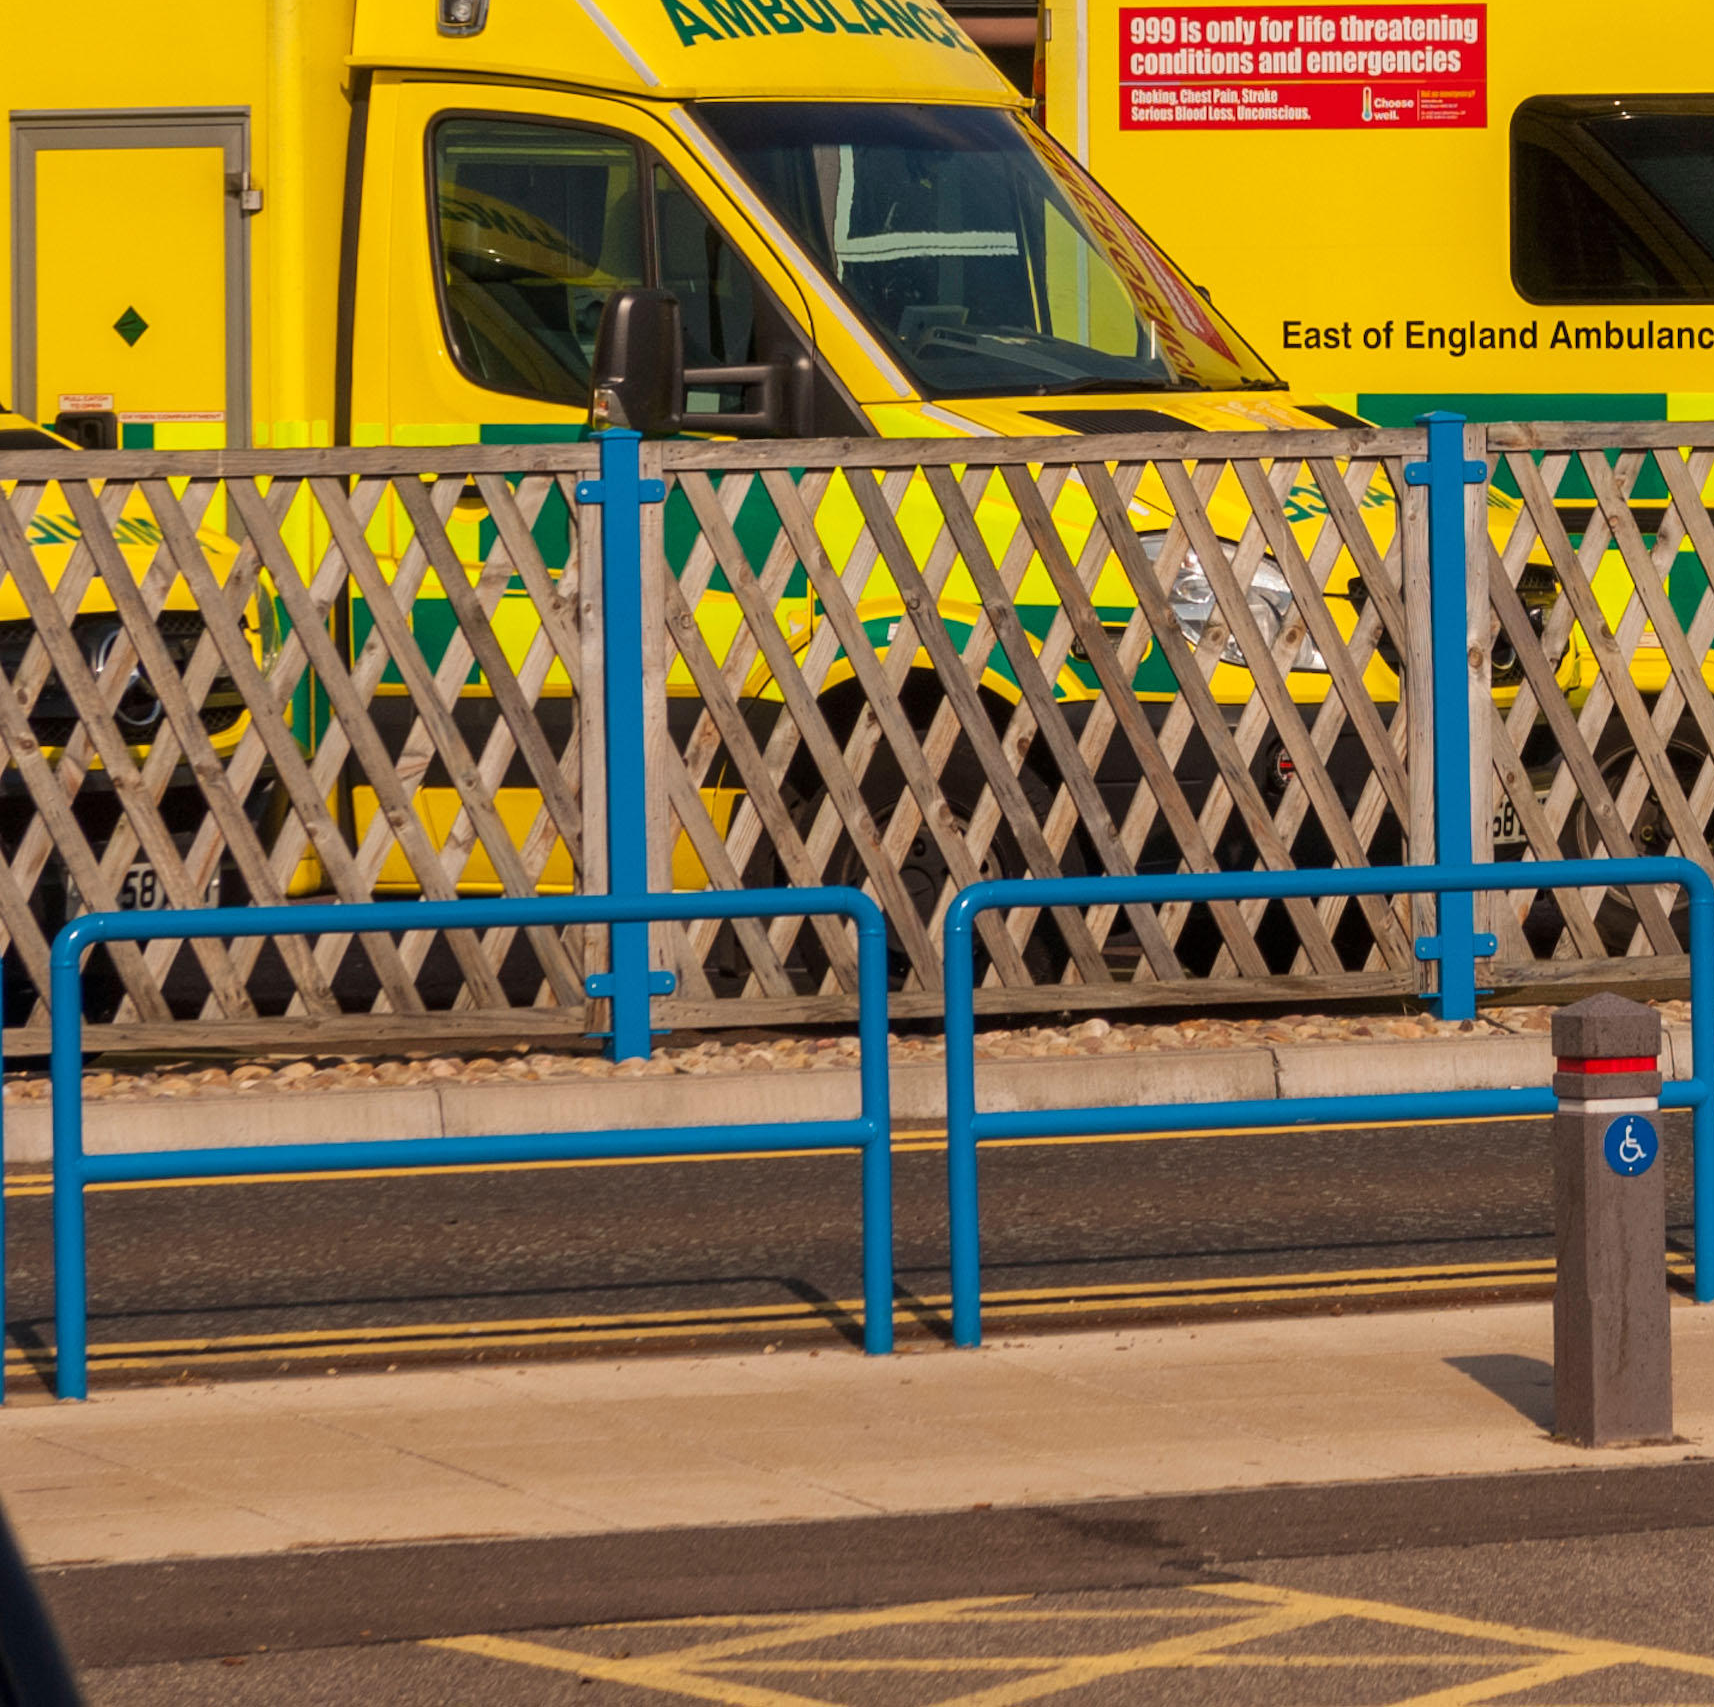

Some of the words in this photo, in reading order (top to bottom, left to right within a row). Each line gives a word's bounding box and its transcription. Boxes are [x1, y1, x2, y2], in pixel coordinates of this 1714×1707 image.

[1130, 16, 1176, 44] 999
[1180, 16, 1201, 43] is
[1209, 16, 1255, 45] only
[1259, 16, 1293, 43] for
[1298, 15, 1336, 42] life
[1340, 14, 1478, 44] threatening
[1130, 48, 1253, 75] conditions
[1258, 47, 1302, 74] and
[1306, 46, 1461, 76] emergencies
[1131, 89, 1178, 105] Choking,
[1180, 89, 1212, 103] Chest
[1213, 88, 1241, 105] Pain,
[1242, 88, 1278, 103] Stroke
[1373, 97, 1414, 109] Choose
[1131, 106, 1174, 122] Serious
[1175, 106, 1206, 121] Blood
[1208, 106, 1236, 122] Loss,
[1237, 105, 1311, 121] Unconscious.
[1373, 110, 1399, 121] well.
[1282, 321, 1352, 350] East
[1362, 320, 1394, 350] of
[1405, 320, 1538, 357] England
